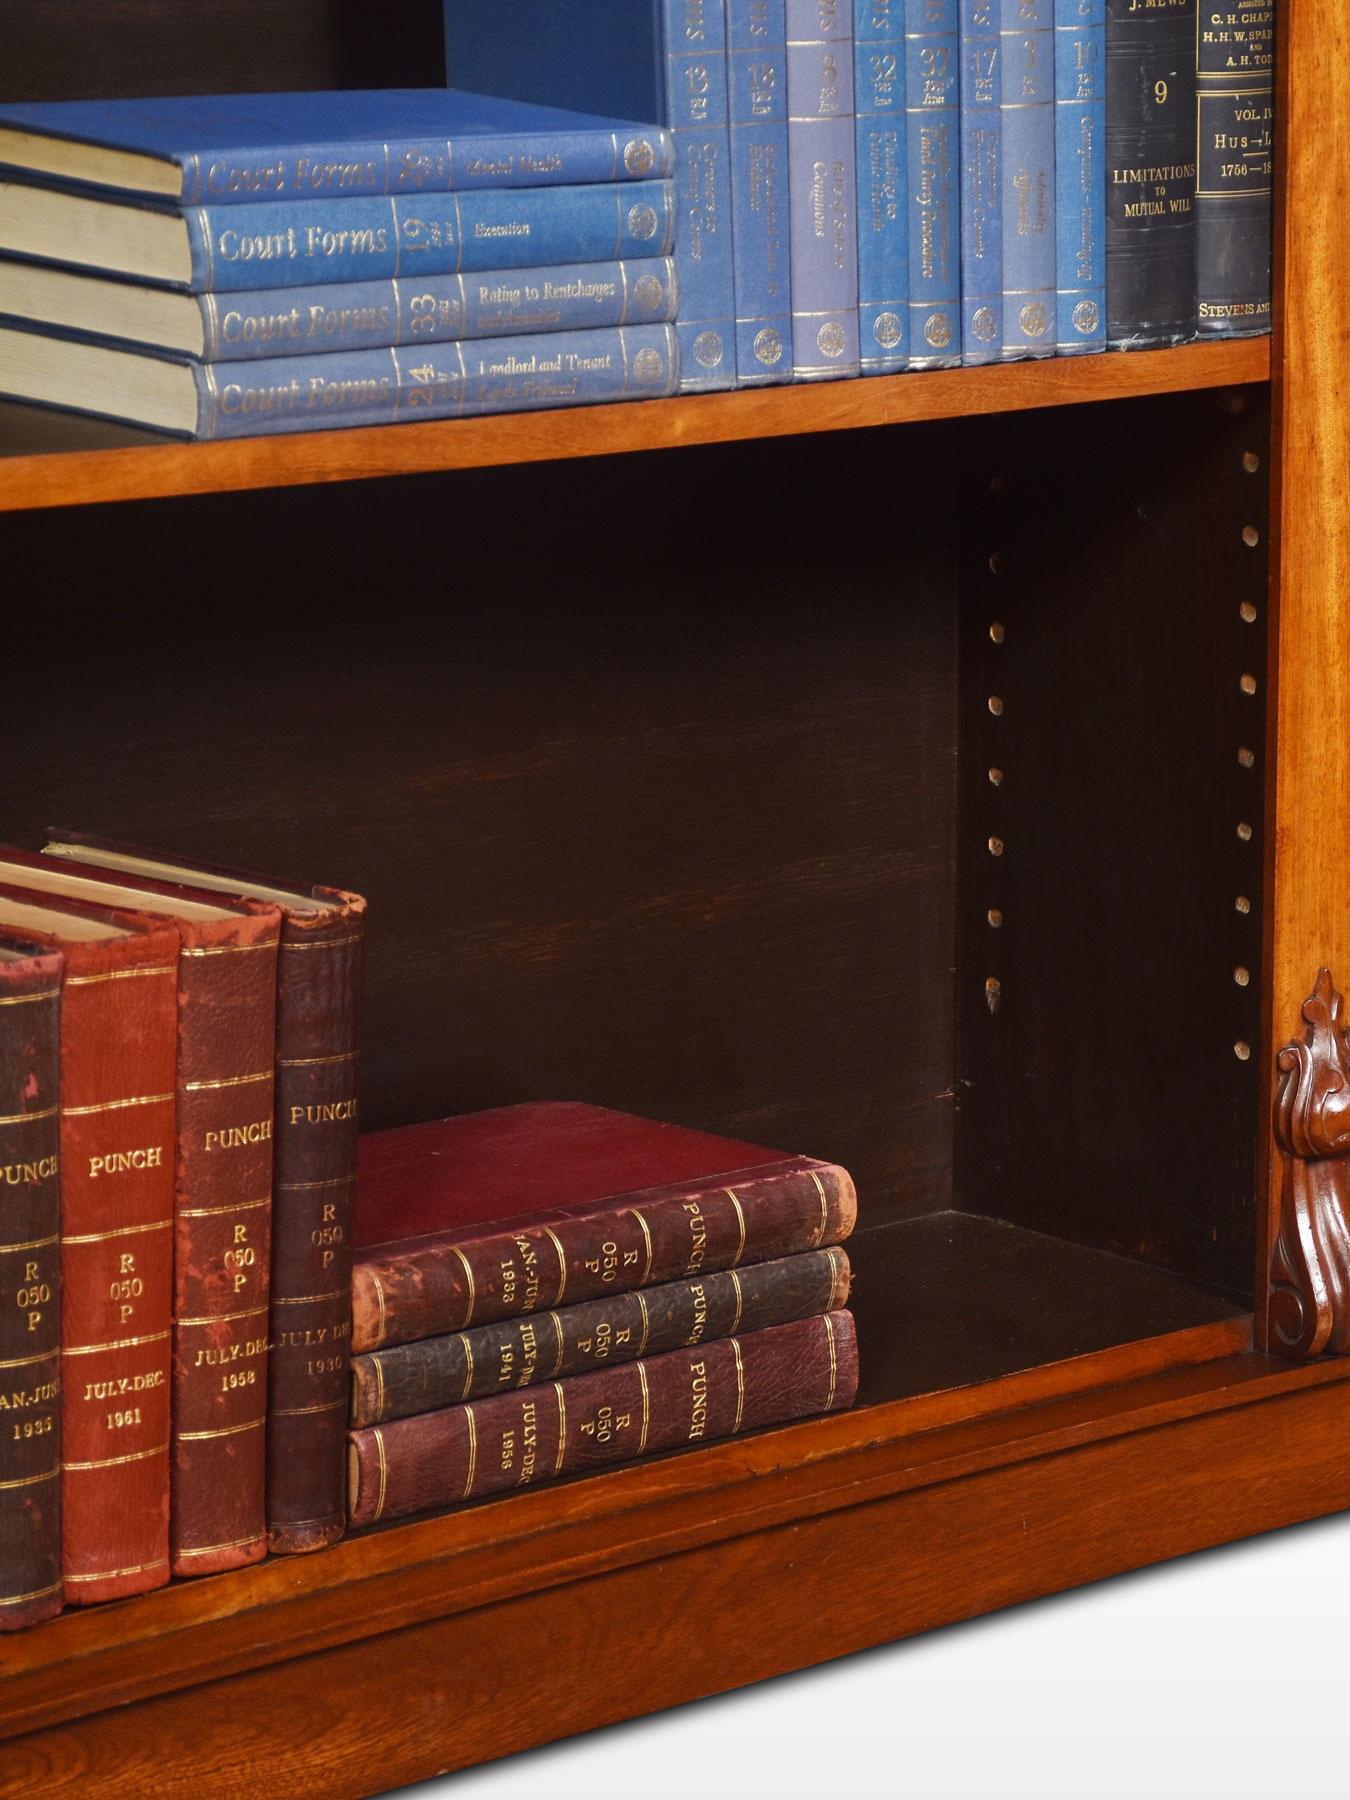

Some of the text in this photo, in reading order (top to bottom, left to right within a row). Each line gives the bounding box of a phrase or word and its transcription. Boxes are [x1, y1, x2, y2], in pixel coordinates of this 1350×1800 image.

[1241, 11, 1272, 24] CHAP
[868, 54, 896, 81] 32
[920, 47, 950, 77] 37
[972, 48, 997, 77] 17
[1154, 80, 1168, 104] 9
[207, 157, 377, 191] Court Forms
[1112, 163, 1195, 184] LIMITATIONS
[1155, 186, 1166, 197] TO
[1124, 201, 1166, 217] MUTUAL
[218, 226, 386, 261] Court Forms
[480, 280, 615, 309] Rating to Rentcharges
[410, 293, 436, 334] 33
[1199, 303, 1255, 317] STEVENS
[222, 306, 389, 342] Court Forms
[478, 353, 611, 377] Landlord and Tenant
[221, 377, 389, 414] Court Forms
[408, 363, 436, 406] 24
[289, 1098, 358, 1125] PUNCH
[204, 1120, 272, 1151] PUNCH
[89, 1147, 162, 1177] PUNCH
[322, 1204, 336, 1222] R
[233, 1224, 247, 1243] R
[311, 1226, 343, 1247] 050
[120, 1253, 135, 1273] R
[224, 1248, 256, 1269] 050
[322, 1251, 334, 1269] P
[585, 1258, 599, 1274] P
[601, 1241, 618, 1282] 050
[624, 1249, 638, 1266] R
[24, 1262, 39, 1282] R
[234, 1274, 247, 1293] P
[500, 1259, 517, 1304] 1933
[16, 1284, 50, 1308] 050
[110, 1278, 143, 1301] 050
[27, 1311, 41, 1331] P
[120, 1305, 133, 1324] P
[577, 1337, 592, 1353] P
[594, 1323, 611, 1358] 050
[616, 1327, 631, 1345] R
[498, 1343, 513, 1382] 1941
[222, 1370, 256, 1392] 1958
[688, 1361, 707, 1440] PUNCH
[107, 1407, 142, 1430] 1961
[581, 1423, 595, 1436] P
[597, 1406, 612, 1443] 050
[615, 1413, 631, 1431] R
[501, 1430, 514, 1470] 1956
[518, 1402, 537, 1484] JULY-DEC
